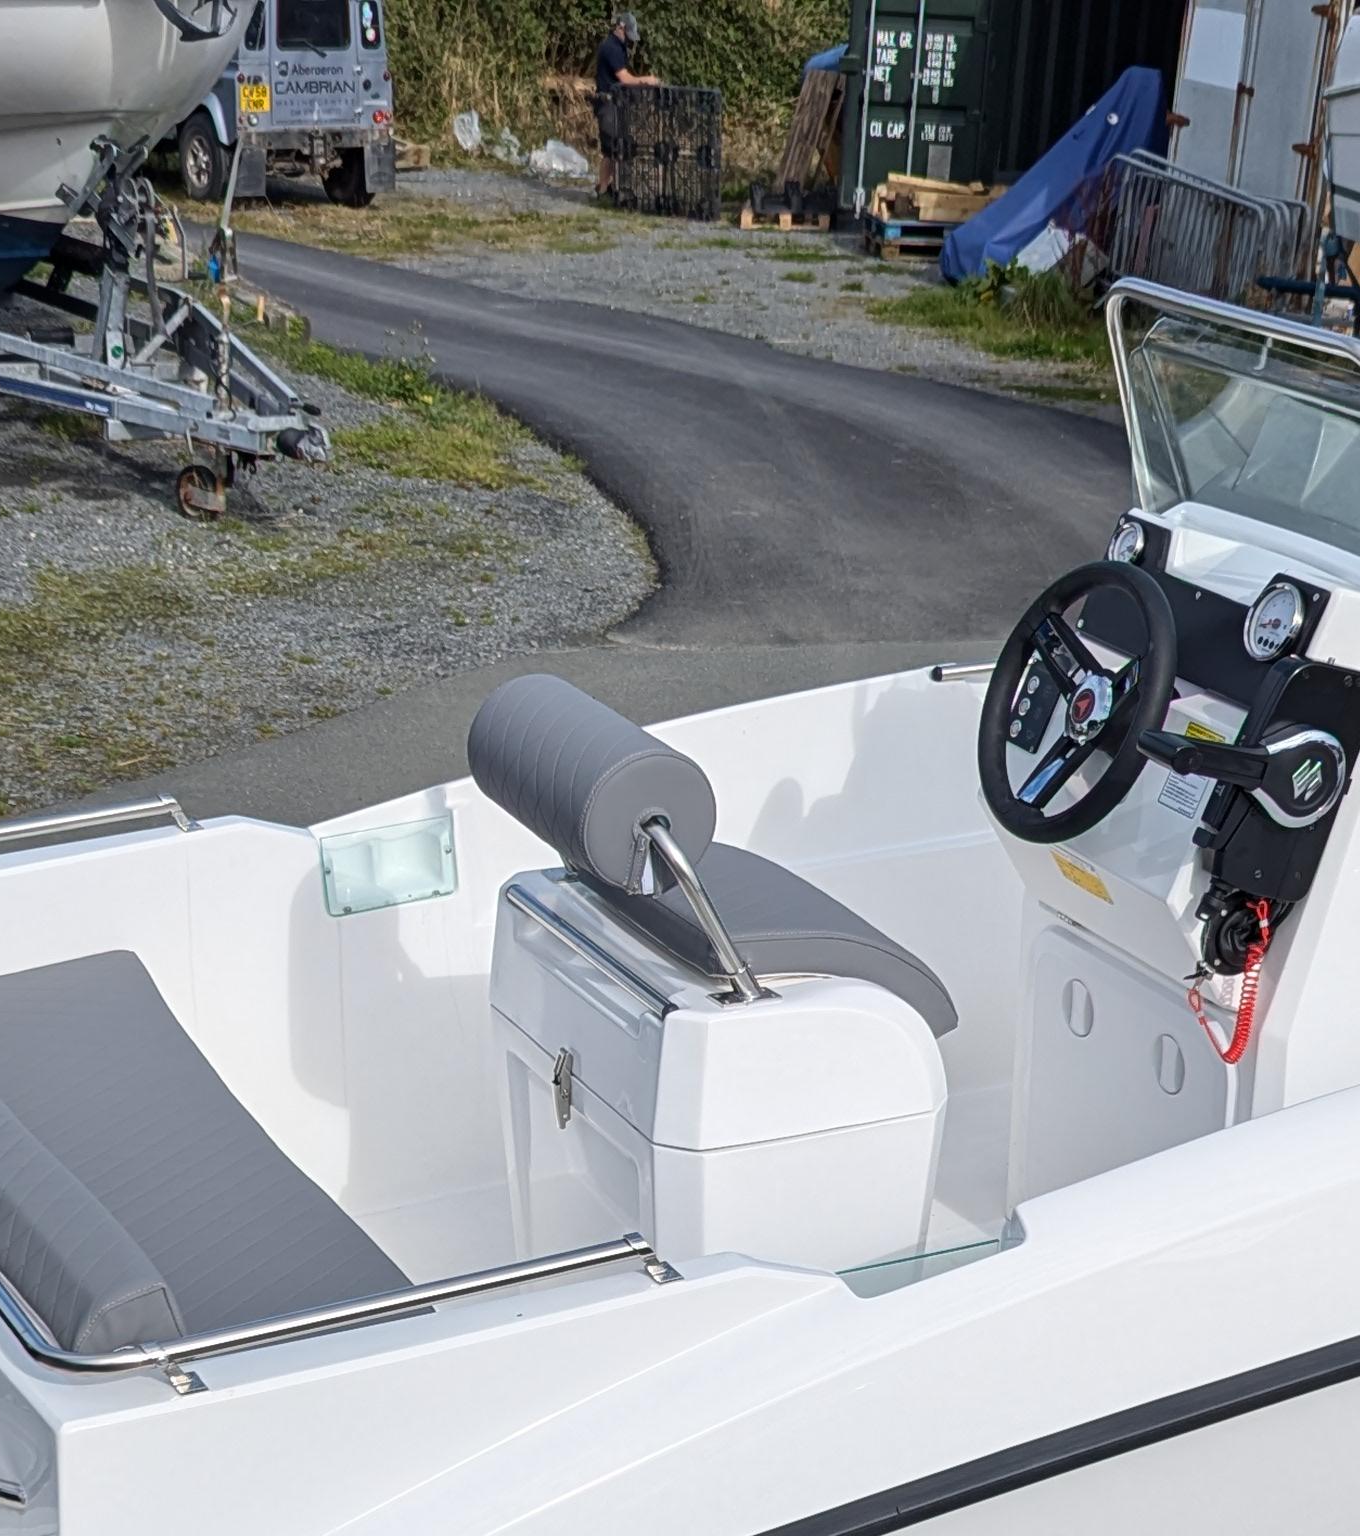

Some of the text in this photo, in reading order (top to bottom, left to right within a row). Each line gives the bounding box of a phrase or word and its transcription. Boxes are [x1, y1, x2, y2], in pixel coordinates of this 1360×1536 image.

[876, 48, 898, 65] TARE
[874, 65, 891, 82] NET
[274, 81, 356, 95] CAMBRIAN
